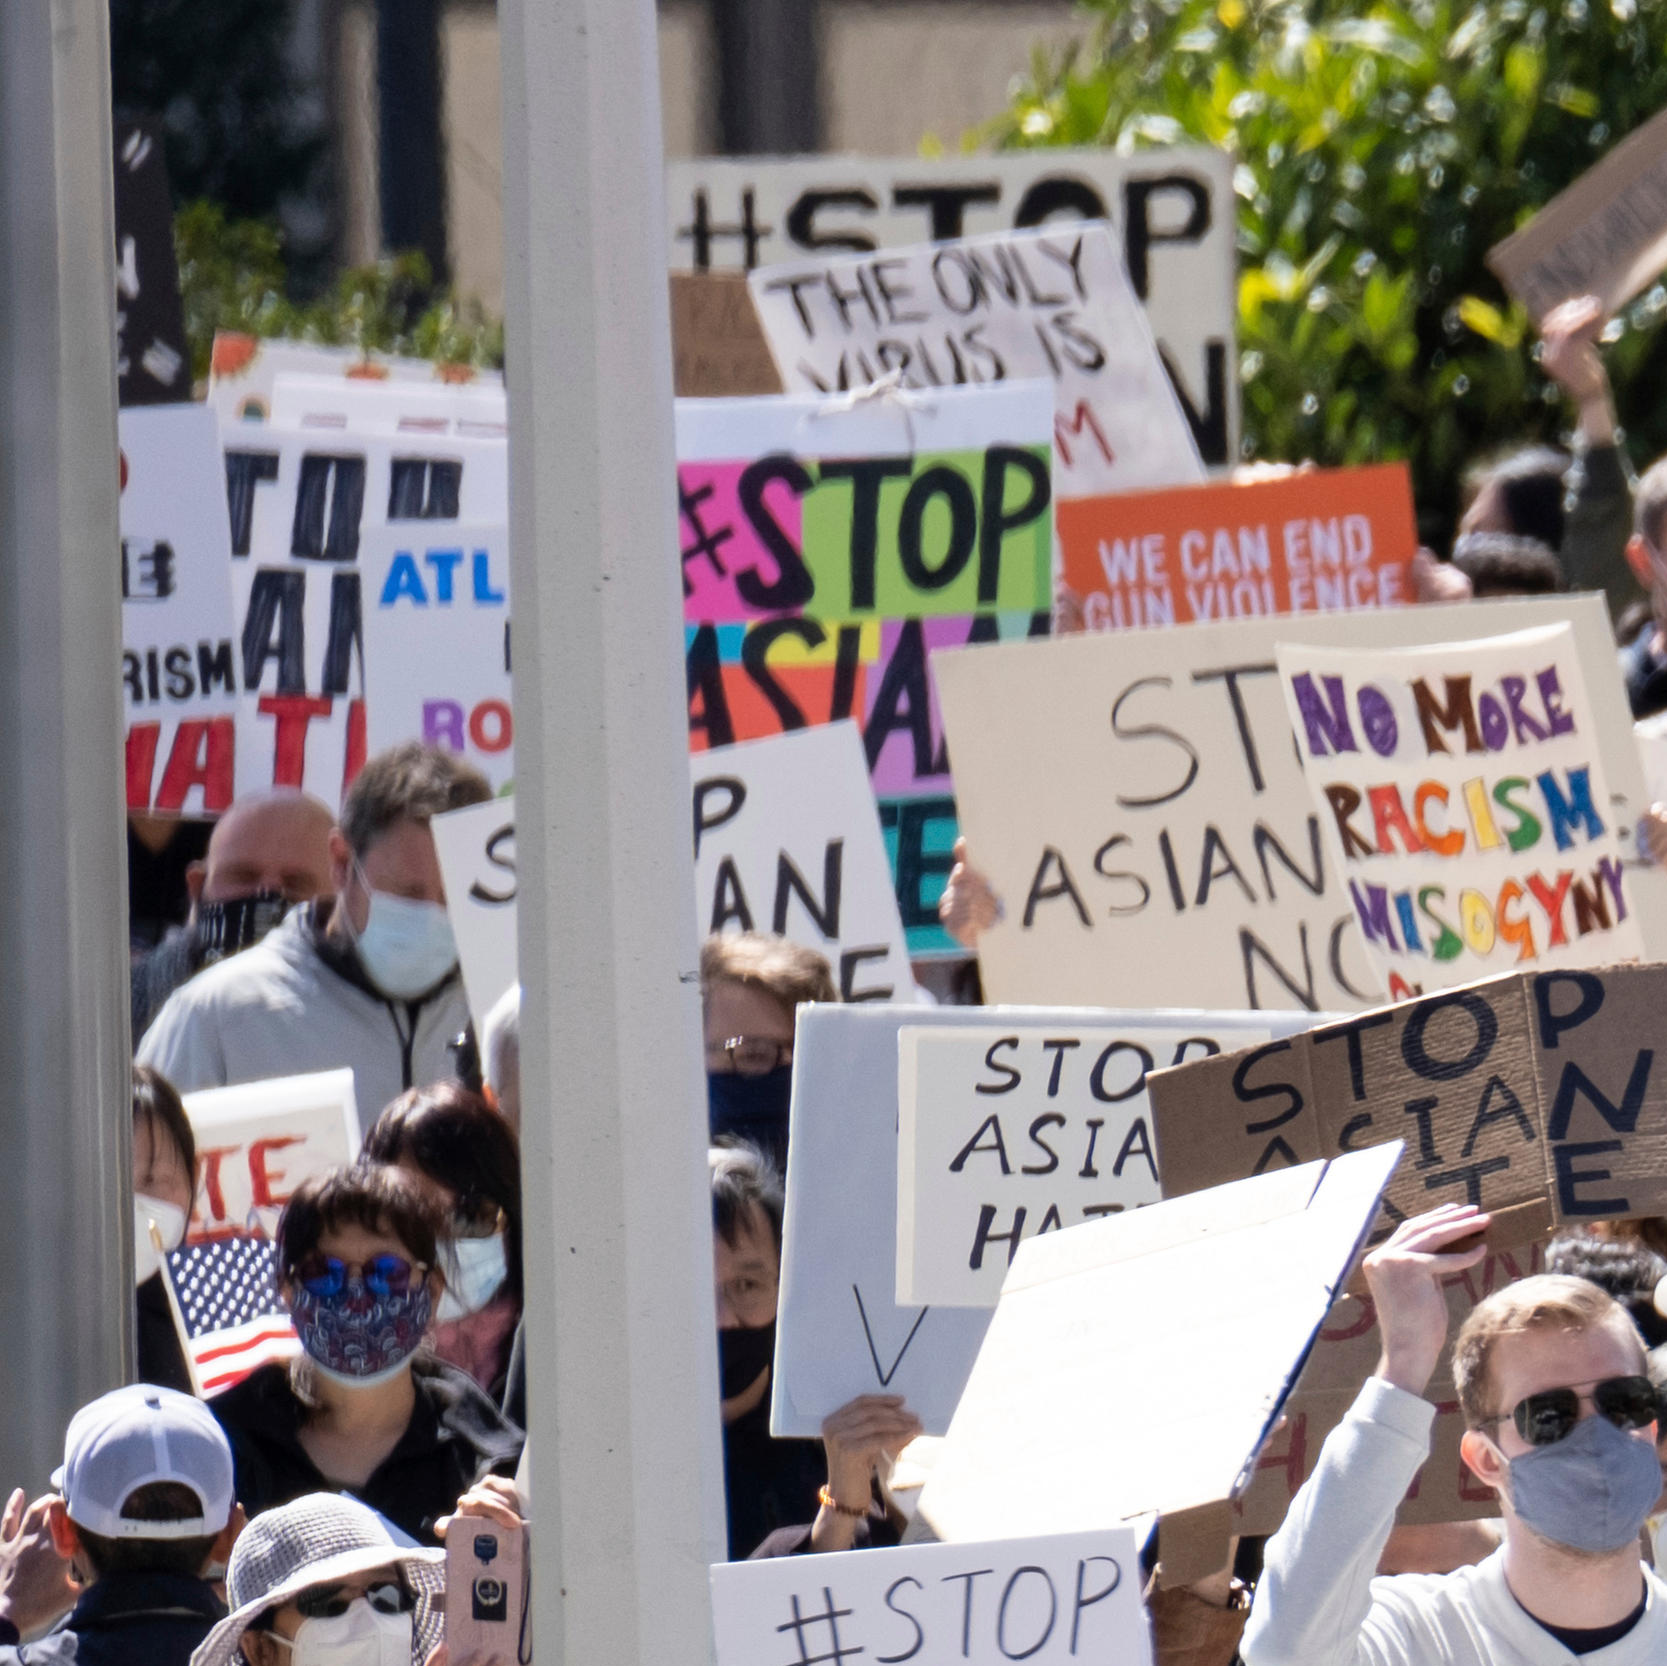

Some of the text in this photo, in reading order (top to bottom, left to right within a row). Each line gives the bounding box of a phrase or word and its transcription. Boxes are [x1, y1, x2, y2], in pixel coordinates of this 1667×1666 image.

[766, 237, 1084, 341] THE ONLY
[1034, 311, 1106, 376] IS
[1083, 561, 1400, 633] GUN VIOLENCE
[1099, 514, 1372, 583] WE CAN END
[1292, 662, 1577, 757] NO MORE
[1325, 763, 1605, 860] RACISM
[1020, 815, 1325, 932] ASIAN
[1350, 852, 1632, 963] MISOGYNY
[1232, 970, 1605, 1135] STOP
